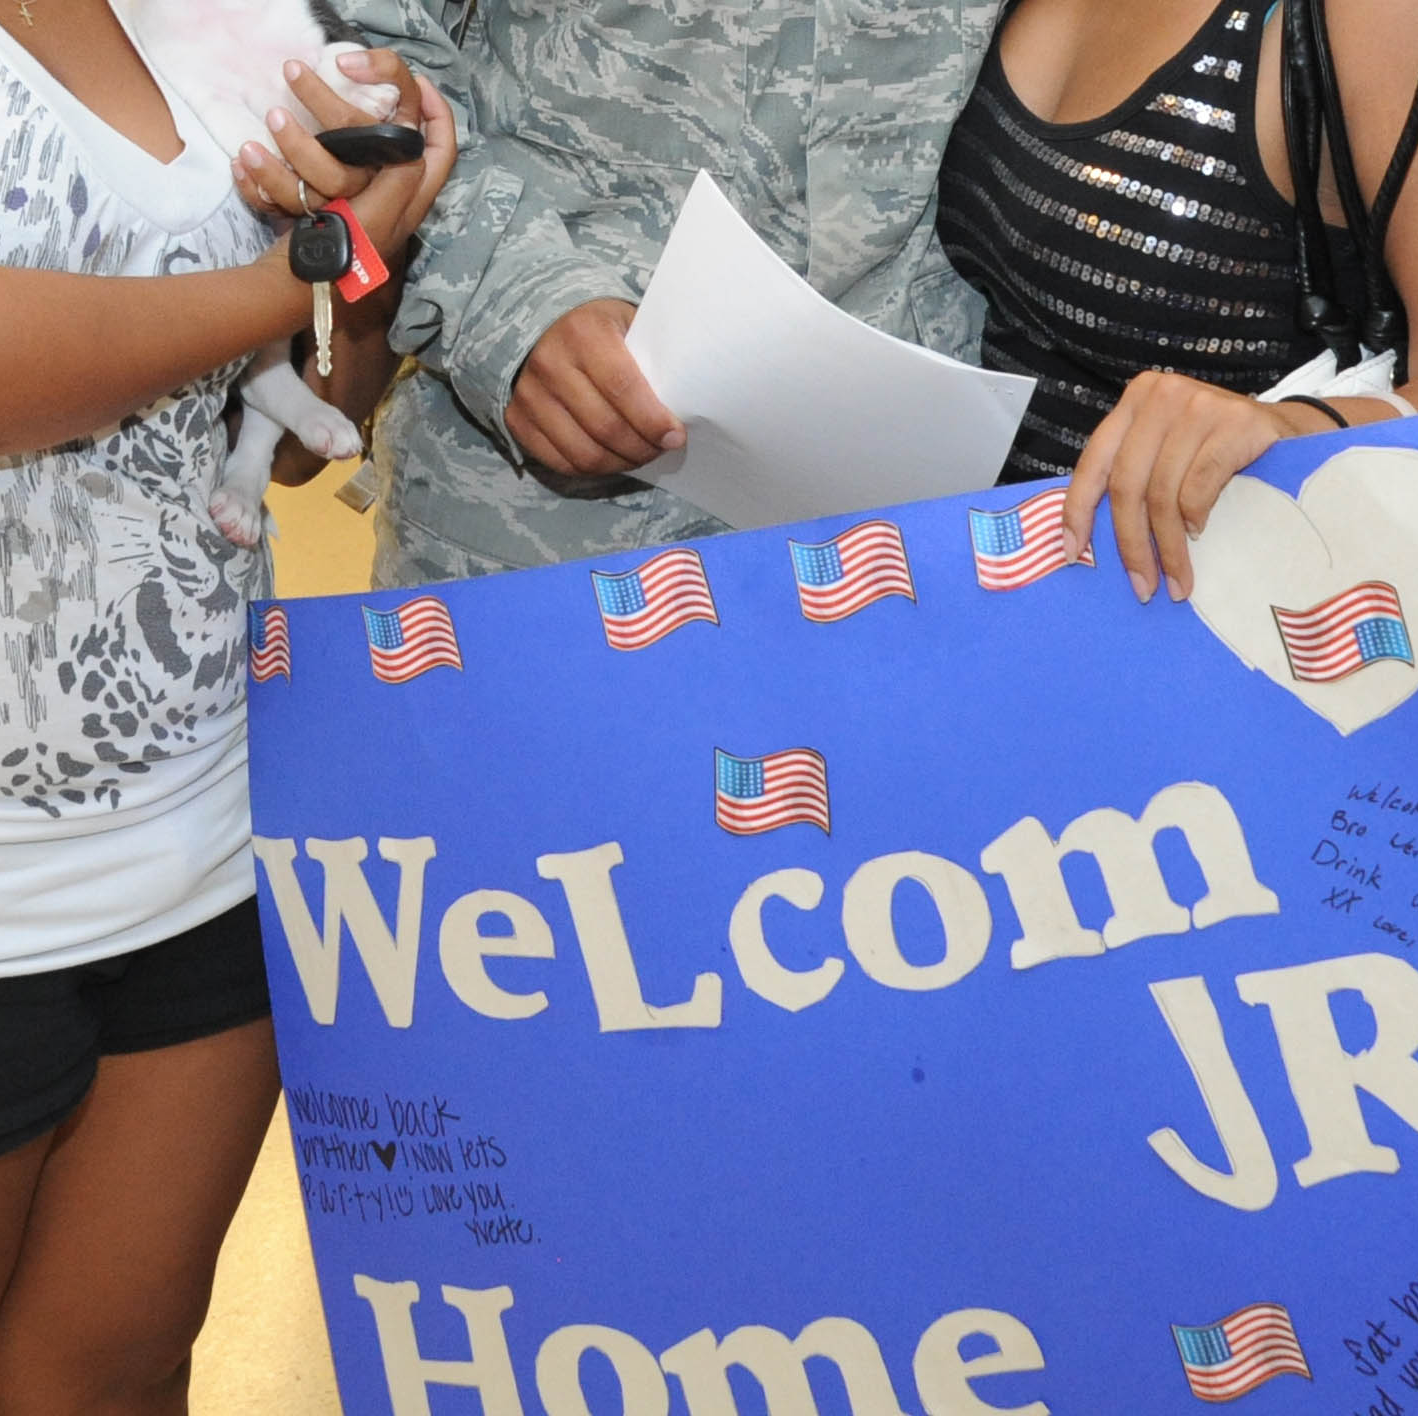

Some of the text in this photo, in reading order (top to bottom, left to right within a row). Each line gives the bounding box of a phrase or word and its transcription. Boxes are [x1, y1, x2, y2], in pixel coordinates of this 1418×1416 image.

[1331, 809, 1368, 838] Bro
[1310, 838, 1382, 891] Drink
[384, 1091, 462, 1138] back
[352, 1273, 1053, 1416] Home
